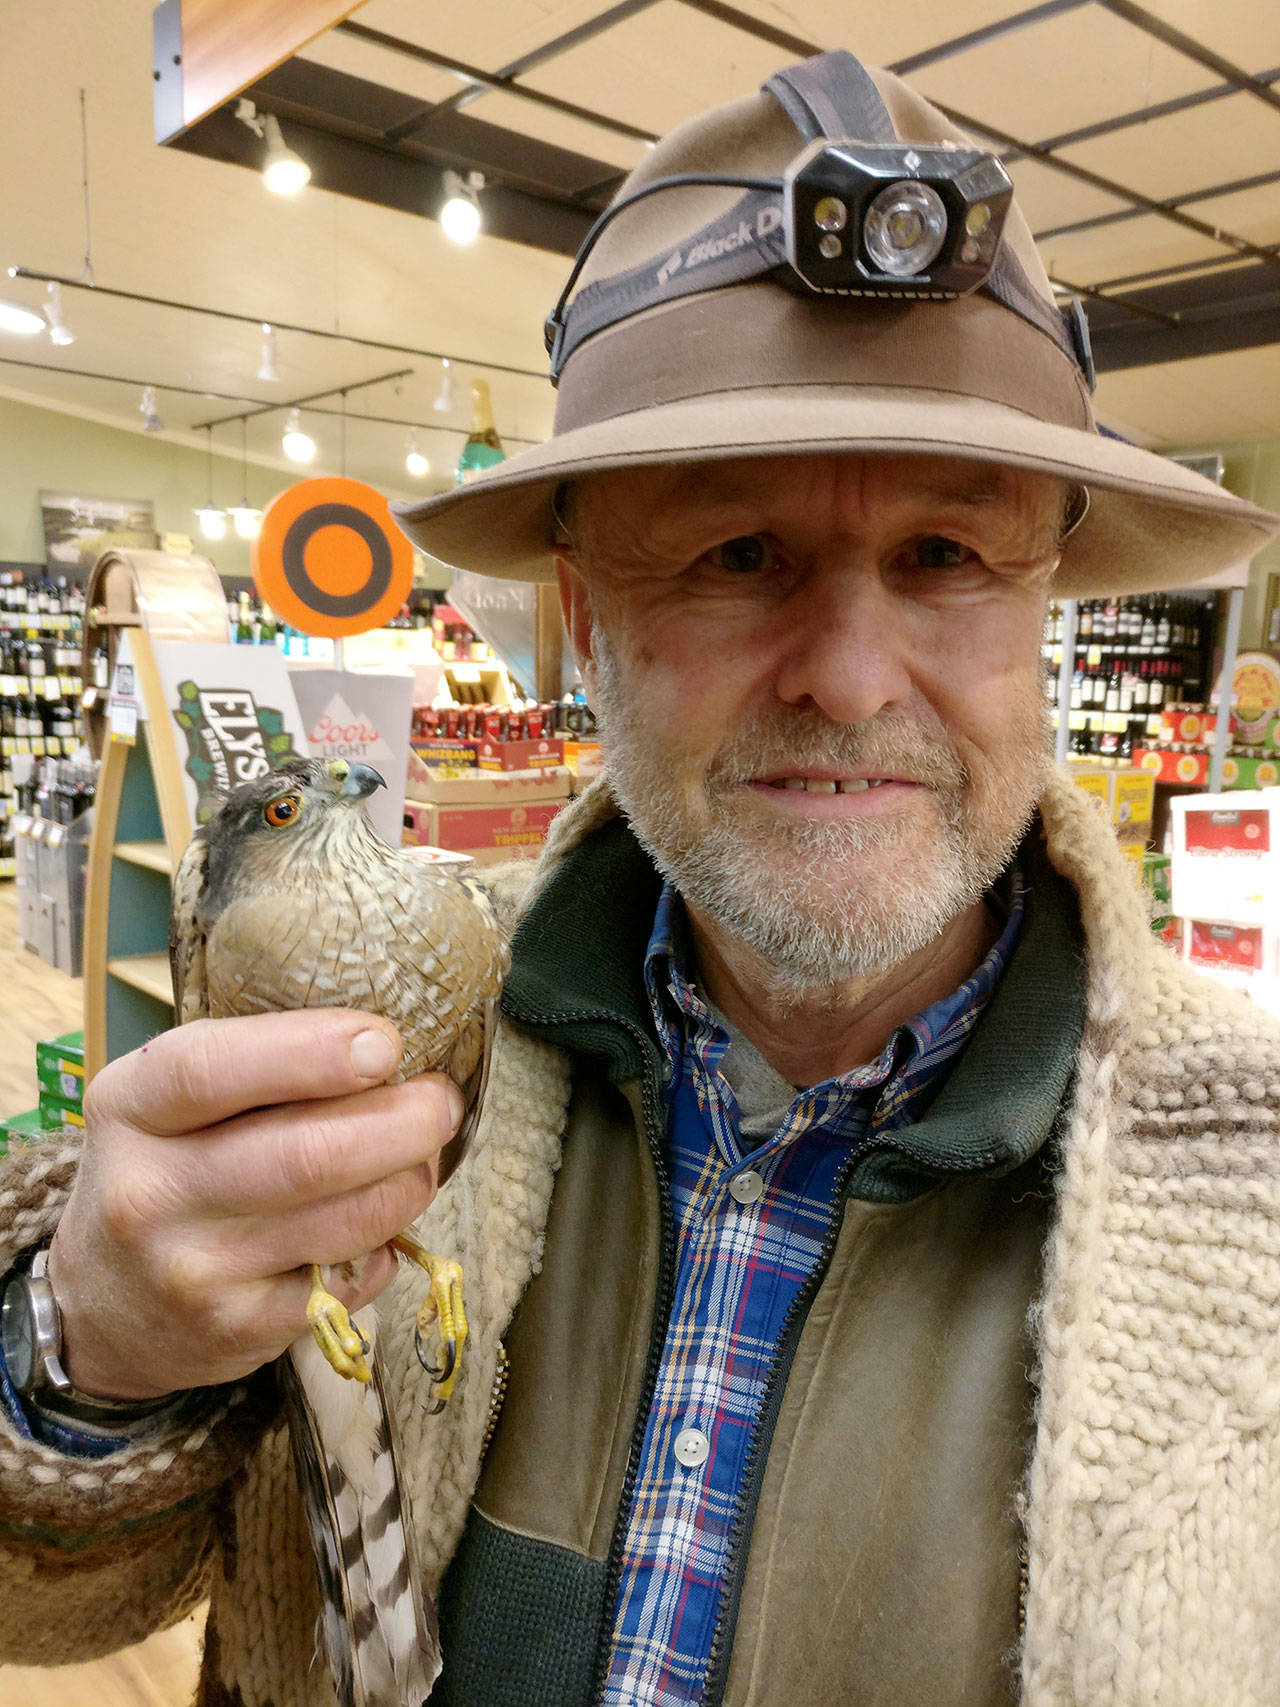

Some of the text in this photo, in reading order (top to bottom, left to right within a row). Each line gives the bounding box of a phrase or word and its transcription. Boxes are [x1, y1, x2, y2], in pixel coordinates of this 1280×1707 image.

[200, 691, 270, 787] ELYS
[308, 714, 379, 743] Coors
[323, 743, 368, 757] LIGHT
